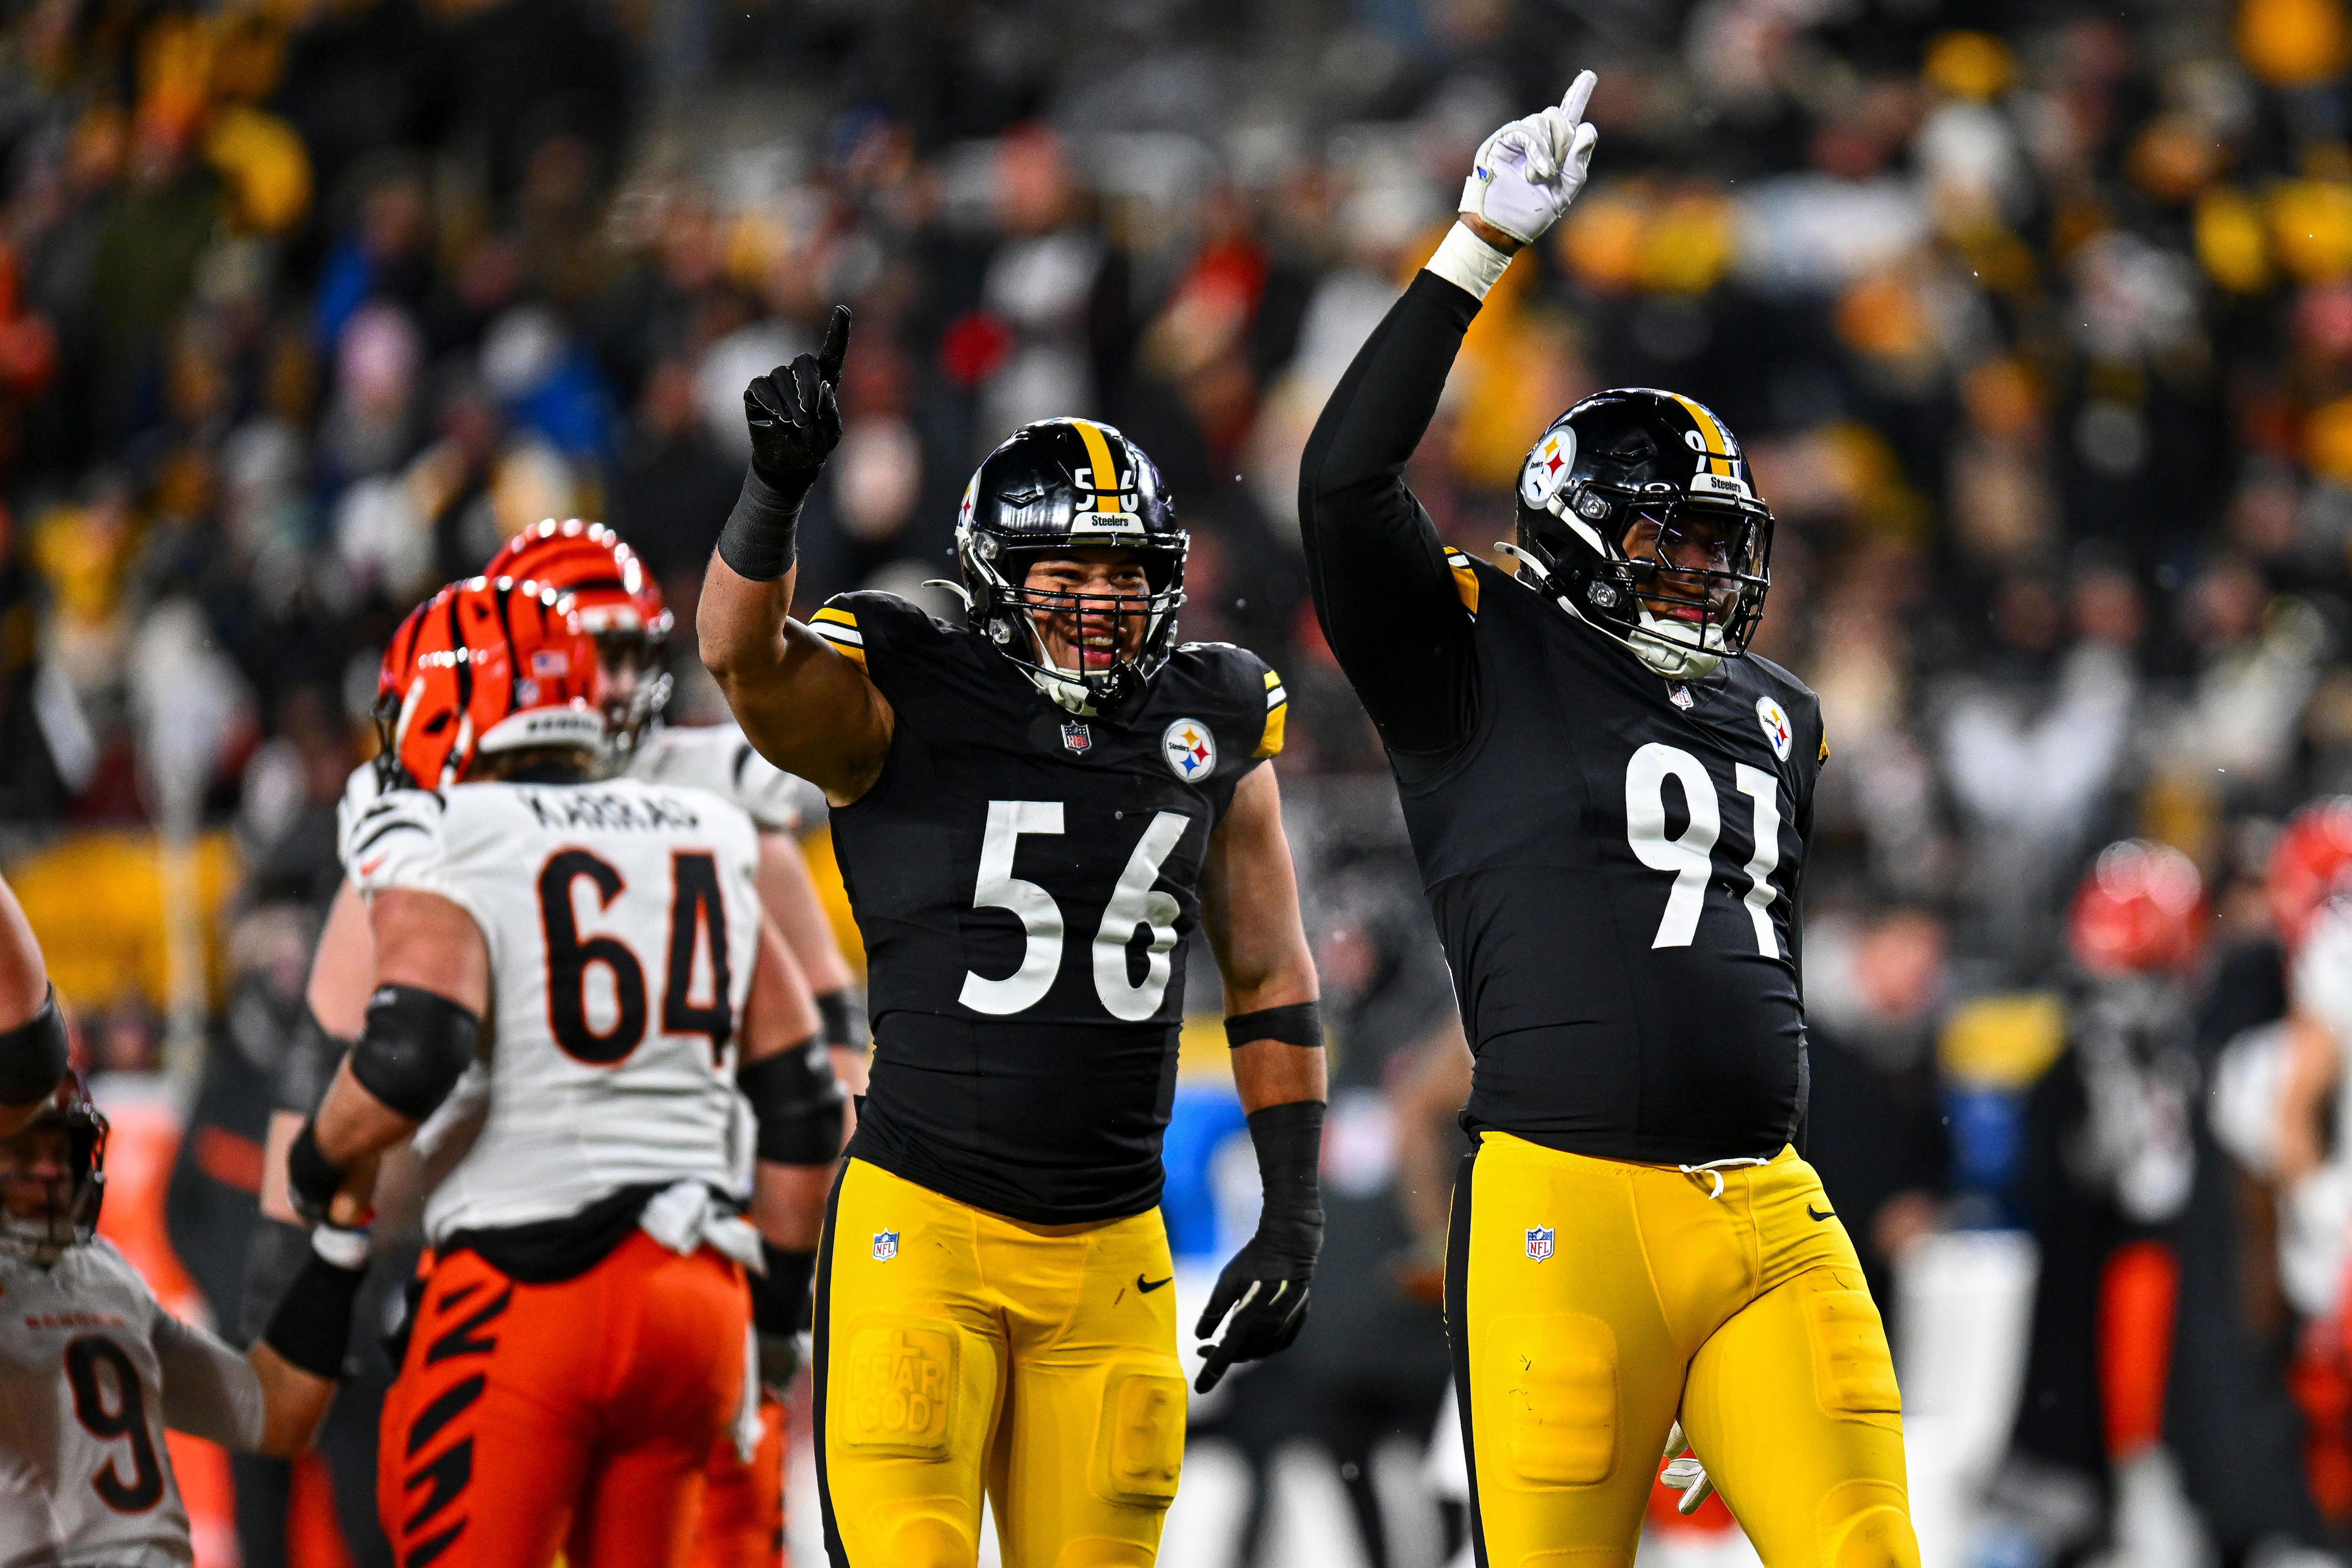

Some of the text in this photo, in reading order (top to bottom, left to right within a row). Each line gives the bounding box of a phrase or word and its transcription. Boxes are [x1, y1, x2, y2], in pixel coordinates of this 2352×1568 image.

[1075, 468, 1138, 512] 56
[1711, 476, 1741, 493] Steelers
[1091, 515, 1128, 527] Steelers
[1067, 735, 1088, 748] NFL
[1168, 742, 1189, 752] Steelers
[1625, 742, 1780, 960] 91
[958, 800, 1190, 1021] 56
[536, 846, 734, 1069] 64
[876, 1243, 892, 1255] NFL
[1530, 1242, 1549, 1255] NFL
[64, 1334, 164, 1515] 9
